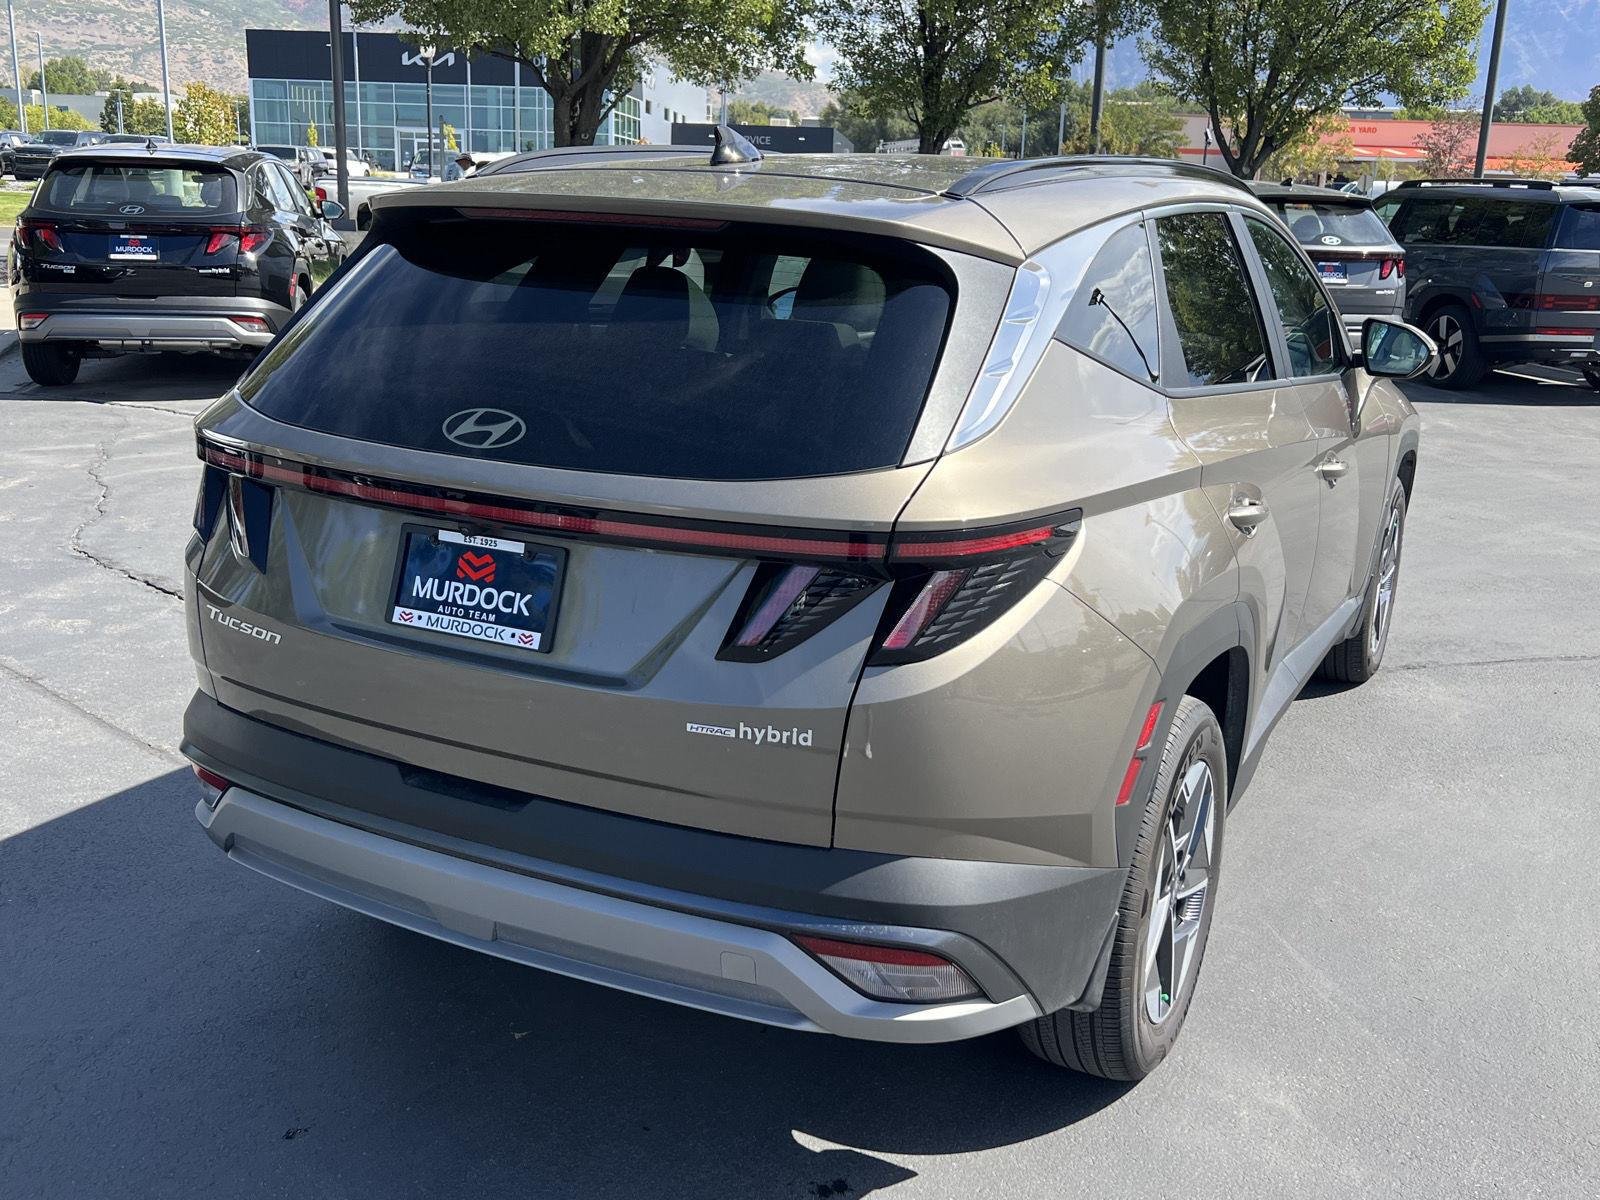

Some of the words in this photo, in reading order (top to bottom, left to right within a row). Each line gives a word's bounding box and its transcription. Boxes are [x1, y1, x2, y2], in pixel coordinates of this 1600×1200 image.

[401, 51, 455, 67] KA
[115, 245, 153, 253] MURDOCK
[463, 535, 479, 545] EST.
[480, 537, 498, 548] 1925
[412, 575, 533, 617] MURDOCK
[437, 605, 465, 617] AUTO
[468, 610, 496, 622] TEAM
[426, 615, 507, 641] MURDOCK
[688, 724, 733, 736] HTRAC
[739, 721, 813, 746] hybrid
